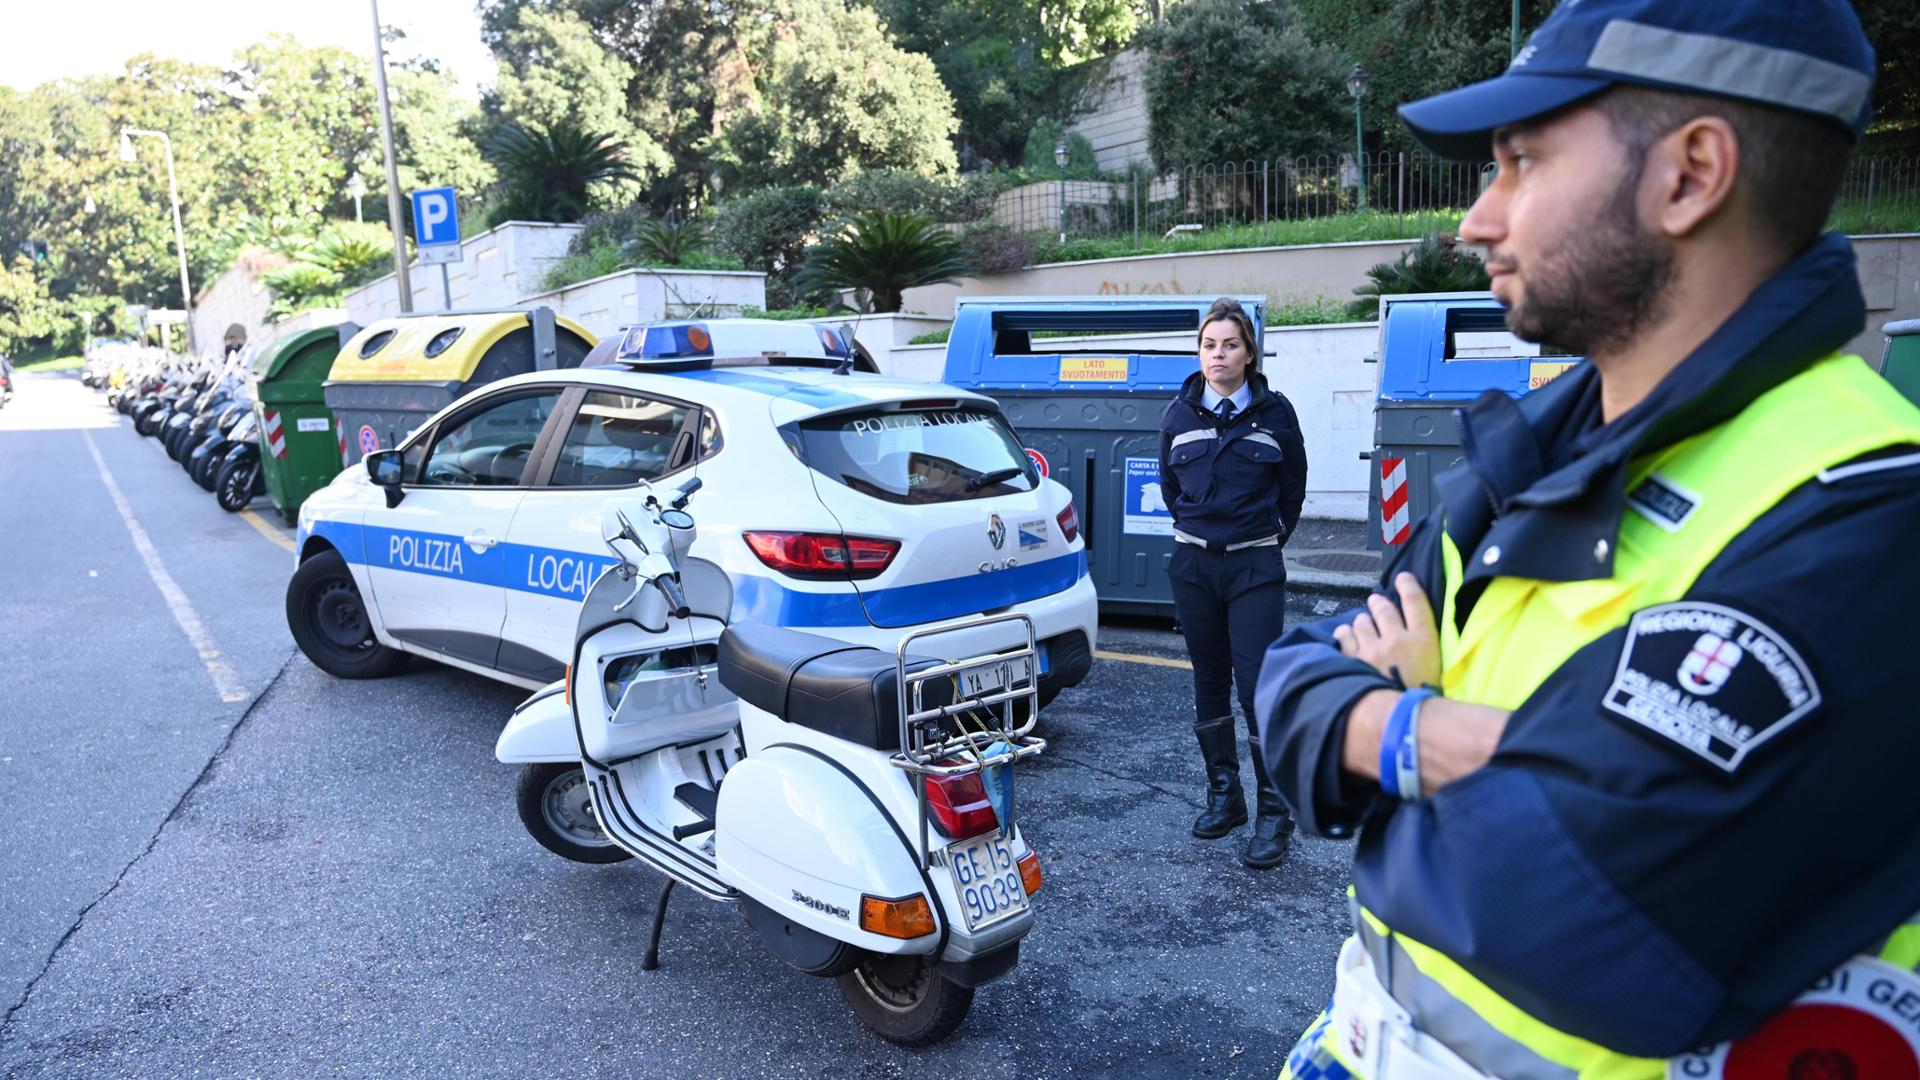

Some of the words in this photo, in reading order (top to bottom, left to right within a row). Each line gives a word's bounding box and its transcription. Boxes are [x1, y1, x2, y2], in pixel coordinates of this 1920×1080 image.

[420, 194, 448, 240] P
[1061, 370, 1126, 380] SVUOTAMENTO
[1083, 360, 1105, 369] LATO
[853, 415, 932, 437] POLIZIA
[933, 411, 995, 428] LOCALE
[389, 535, 464, 574] POLIZIA
[527, 554, 609, 595] LOCAL
[978, 557, 1018, 573] CLIO
[1638, 610, 1738, 638] REGIONE
[1737, 627, 1809, 709] LIGURIA
[967, 674, 983, 693] YA
[1622, 668, 1681, 706] POLIZIA
[1679, 694, 1754, 743] LOCALE
[1625, 697, 1710, 751] GENOVA
[953, 846, 986, 885] GE
[985, 838, 1011, 873] 15
[965, 872, 1022, 920] 9039
